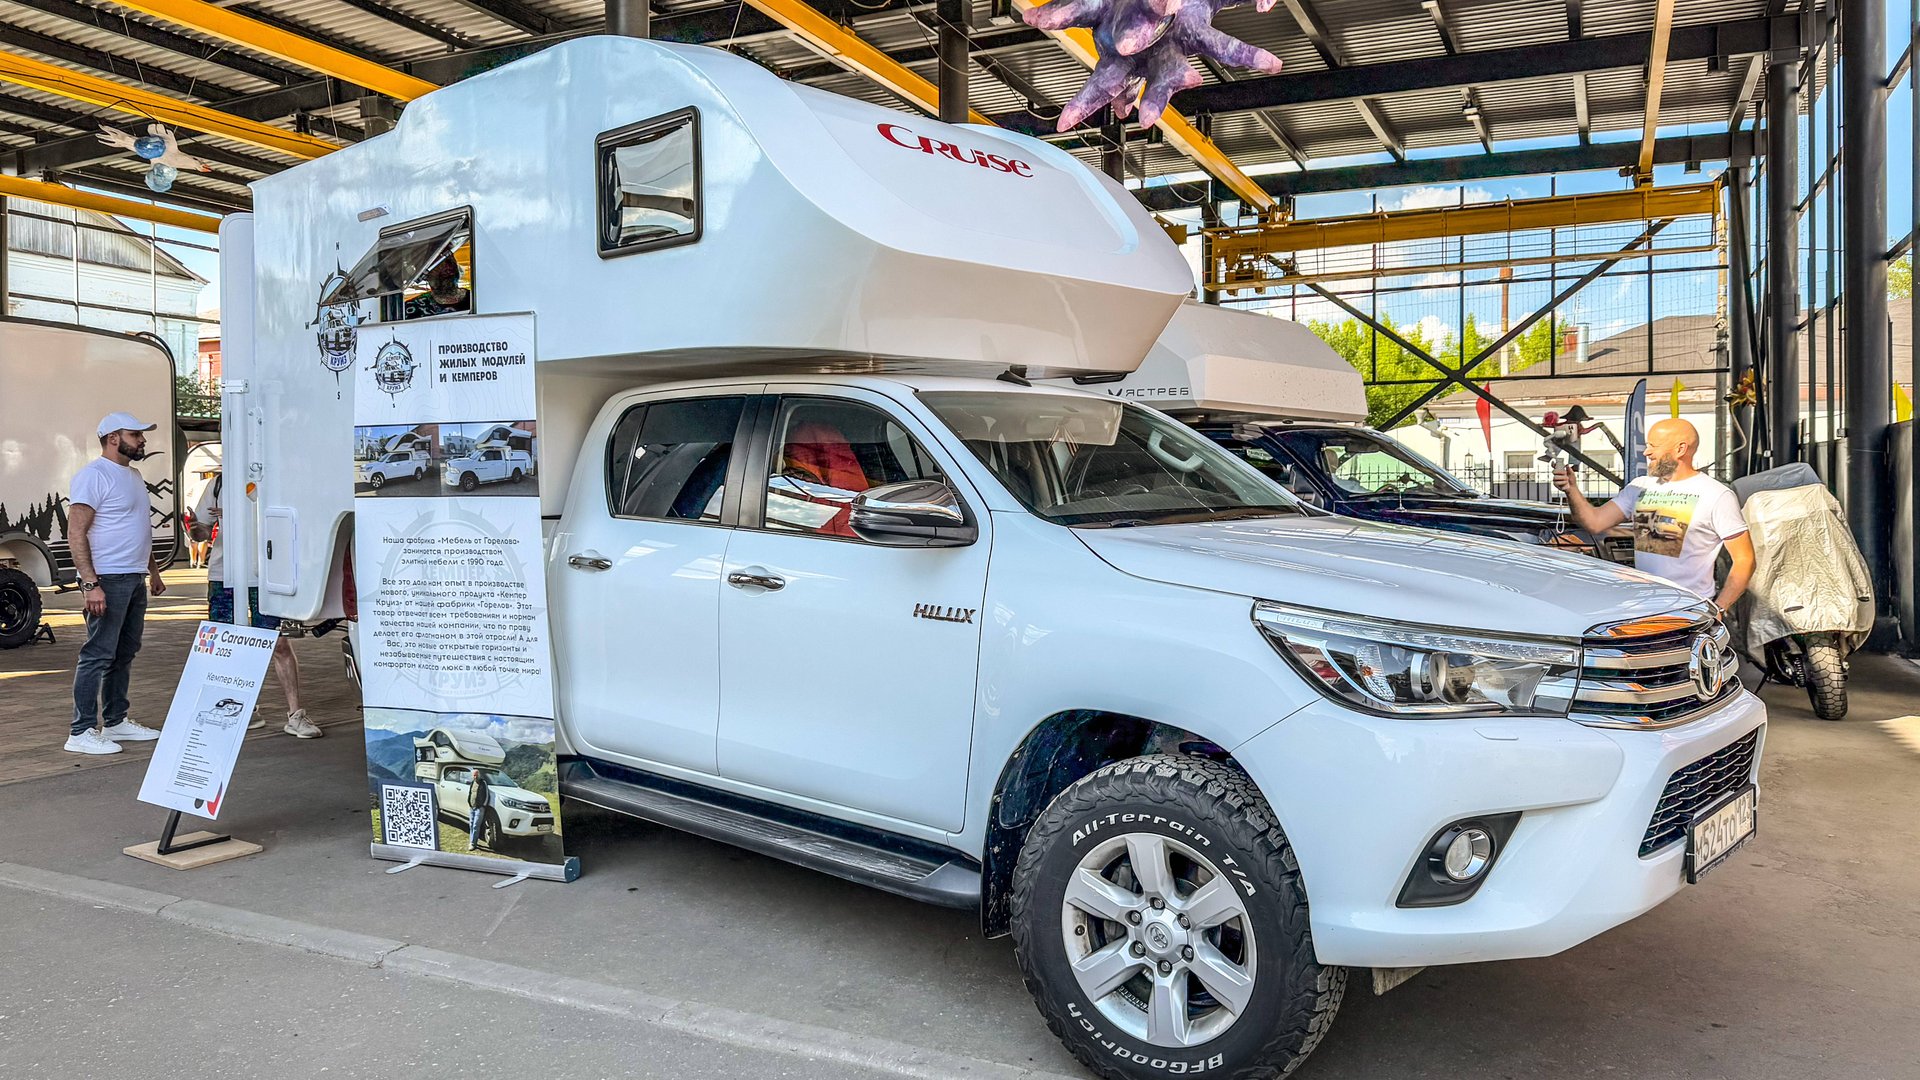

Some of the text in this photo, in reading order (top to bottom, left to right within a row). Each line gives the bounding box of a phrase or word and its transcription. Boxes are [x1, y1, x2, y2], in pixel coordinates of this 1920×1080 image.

[438, 341, 509, 355] ПРОИЗВОДСТВО
[330, 355, 348, 366] КРУИЗ
[439, 353, 526, 369] ЖИЛЫХ МОДУЛЕЙ
[439, 371, 498, 383] И КЕМПЕРОВ
[1126, 387, 1189, 397] ЯСТРЕБ
[382, 536, 405, 545] Наша
[406, 537, 436, 547] фабрика
[438, 536, 472, 545] «Мебель
[483, 537, 520, 546] Горелова»
[403, 548, 503, 557] занимается производством
[401, 558, 428, 566] элитной
[428, 558, 459, 567] мебели
[467, 558, 485, 567] 1990
[486, 560, 506, 568] года.
[382, 577, 397, 586] Все
[412, 579, 428, 587] дало
[444, 580, 467, 588] опыт
[474, 580, 525, 589] производстве
[380, 589, 528, 600] нового, уникального продукта «Кемпер
[375, 598, 402, 607] Круиз»
[414, 599, 435, 608] нашей
[436, 600, 476, 609] фабрики
[516, 601, 533, 610] Этот
[373, 609, 396, 618] товар
[397, 610, 429, 618] отвечает
[428, 611, 447, 619] всем
[449, 612, 501, 620] требованиям
[509, 614, 537, 622] нормам
[912, 602, 977, 625] HILUX
[380, 620, 415, 628] качества
[416, 620, 437, 629] нашей
[438, 622, 481, 630] компании,
[508, 624, 531, 633] праву
[220, 630, 275, 650] Caravanex
[373, 630, 400, 638] делает
[401, 631, 414, 639] его
[465, 632, 484, 640] этой
[485, 633, 517, 642] отрасли!
[518, 634, 525, 643] А
[525, 636, 539, 644] для
[215, 647, 233, 658] 2025
[386, 639, 403, 648] Вас,
[417, 641, 438, 650] новые
[438, 642, 480, 651] открытые
[481, 643, 521, 653] горизонты
[522, 645, 528, 653] и
[379, 650, 432, 660] незабываемые
[432, 653, 486, 663] путешествия
[493, 655, 535, 665] настоящим
[373, 661, 417, 669] комфортом
[417, 662, 440, 671] класса
[472, 663, 497, 673] любой
[498, 666, 520, 674] точке
[521, 667, 542, 676] мира!
[206, 671, 255, 689] Кемпер Круиз
[1072, 812, 1257, 898] All-Terrain T/A
[1067, 1002, 1224, 1074] BFGoodrich
